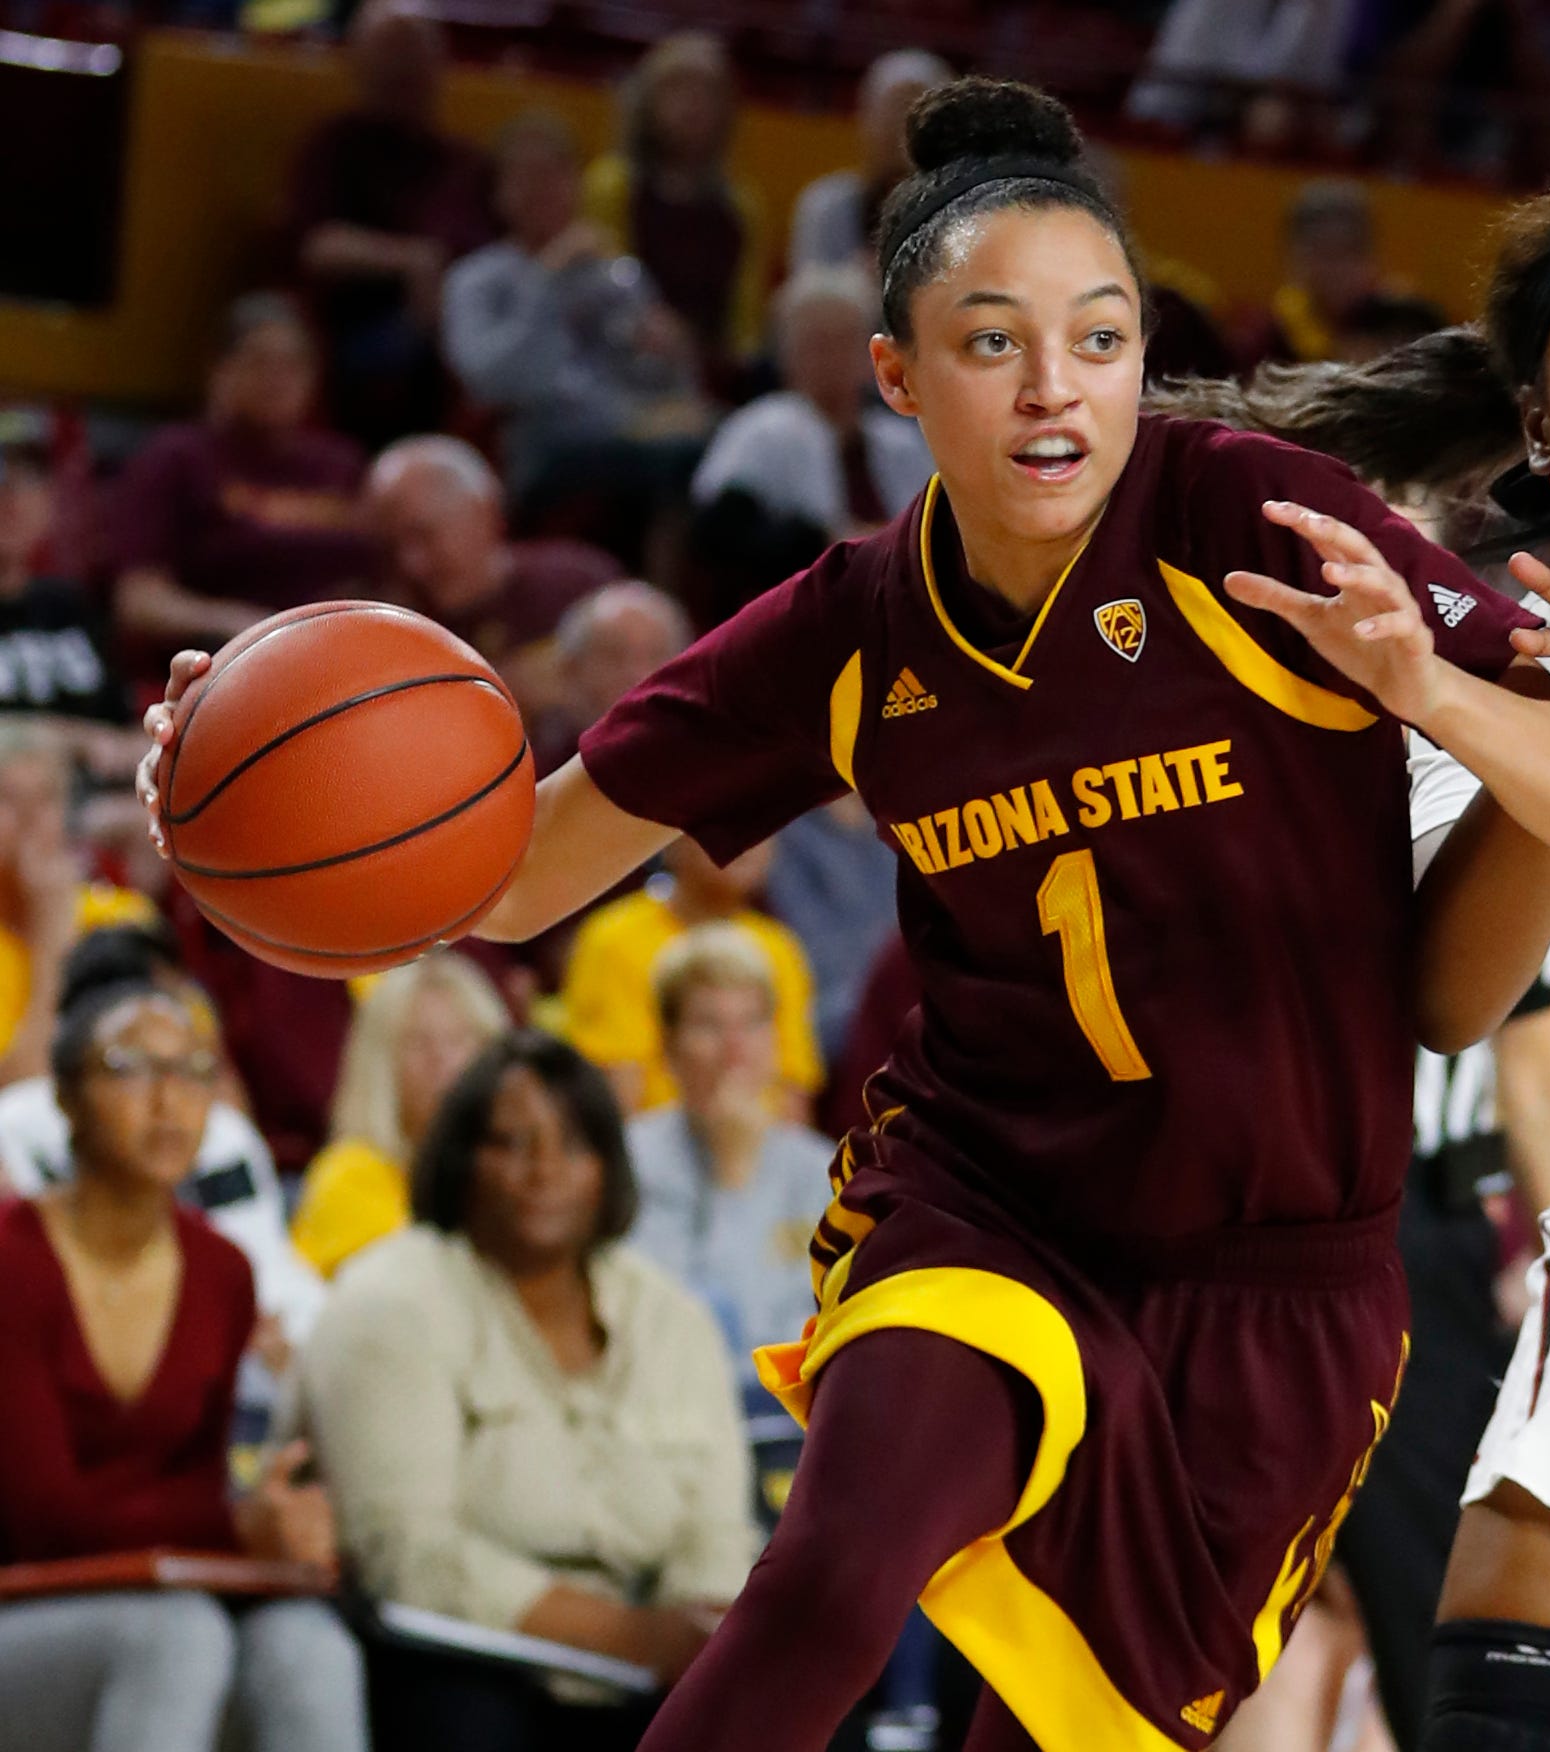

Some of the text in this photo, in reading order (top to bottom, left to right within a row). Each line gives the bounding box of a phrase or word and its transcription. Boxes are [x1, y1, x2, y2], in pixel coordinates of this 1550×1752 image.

[1097, 602, 1142, 641] PAC
[1114, 626, 1140, 651] 12
[882, 694, 938, 719] adidas
[1071, 739, 1244, 829] STATE
[890, 778, 1069, 875] RIZONA
[1036, 848, 1152, 1082] 1
